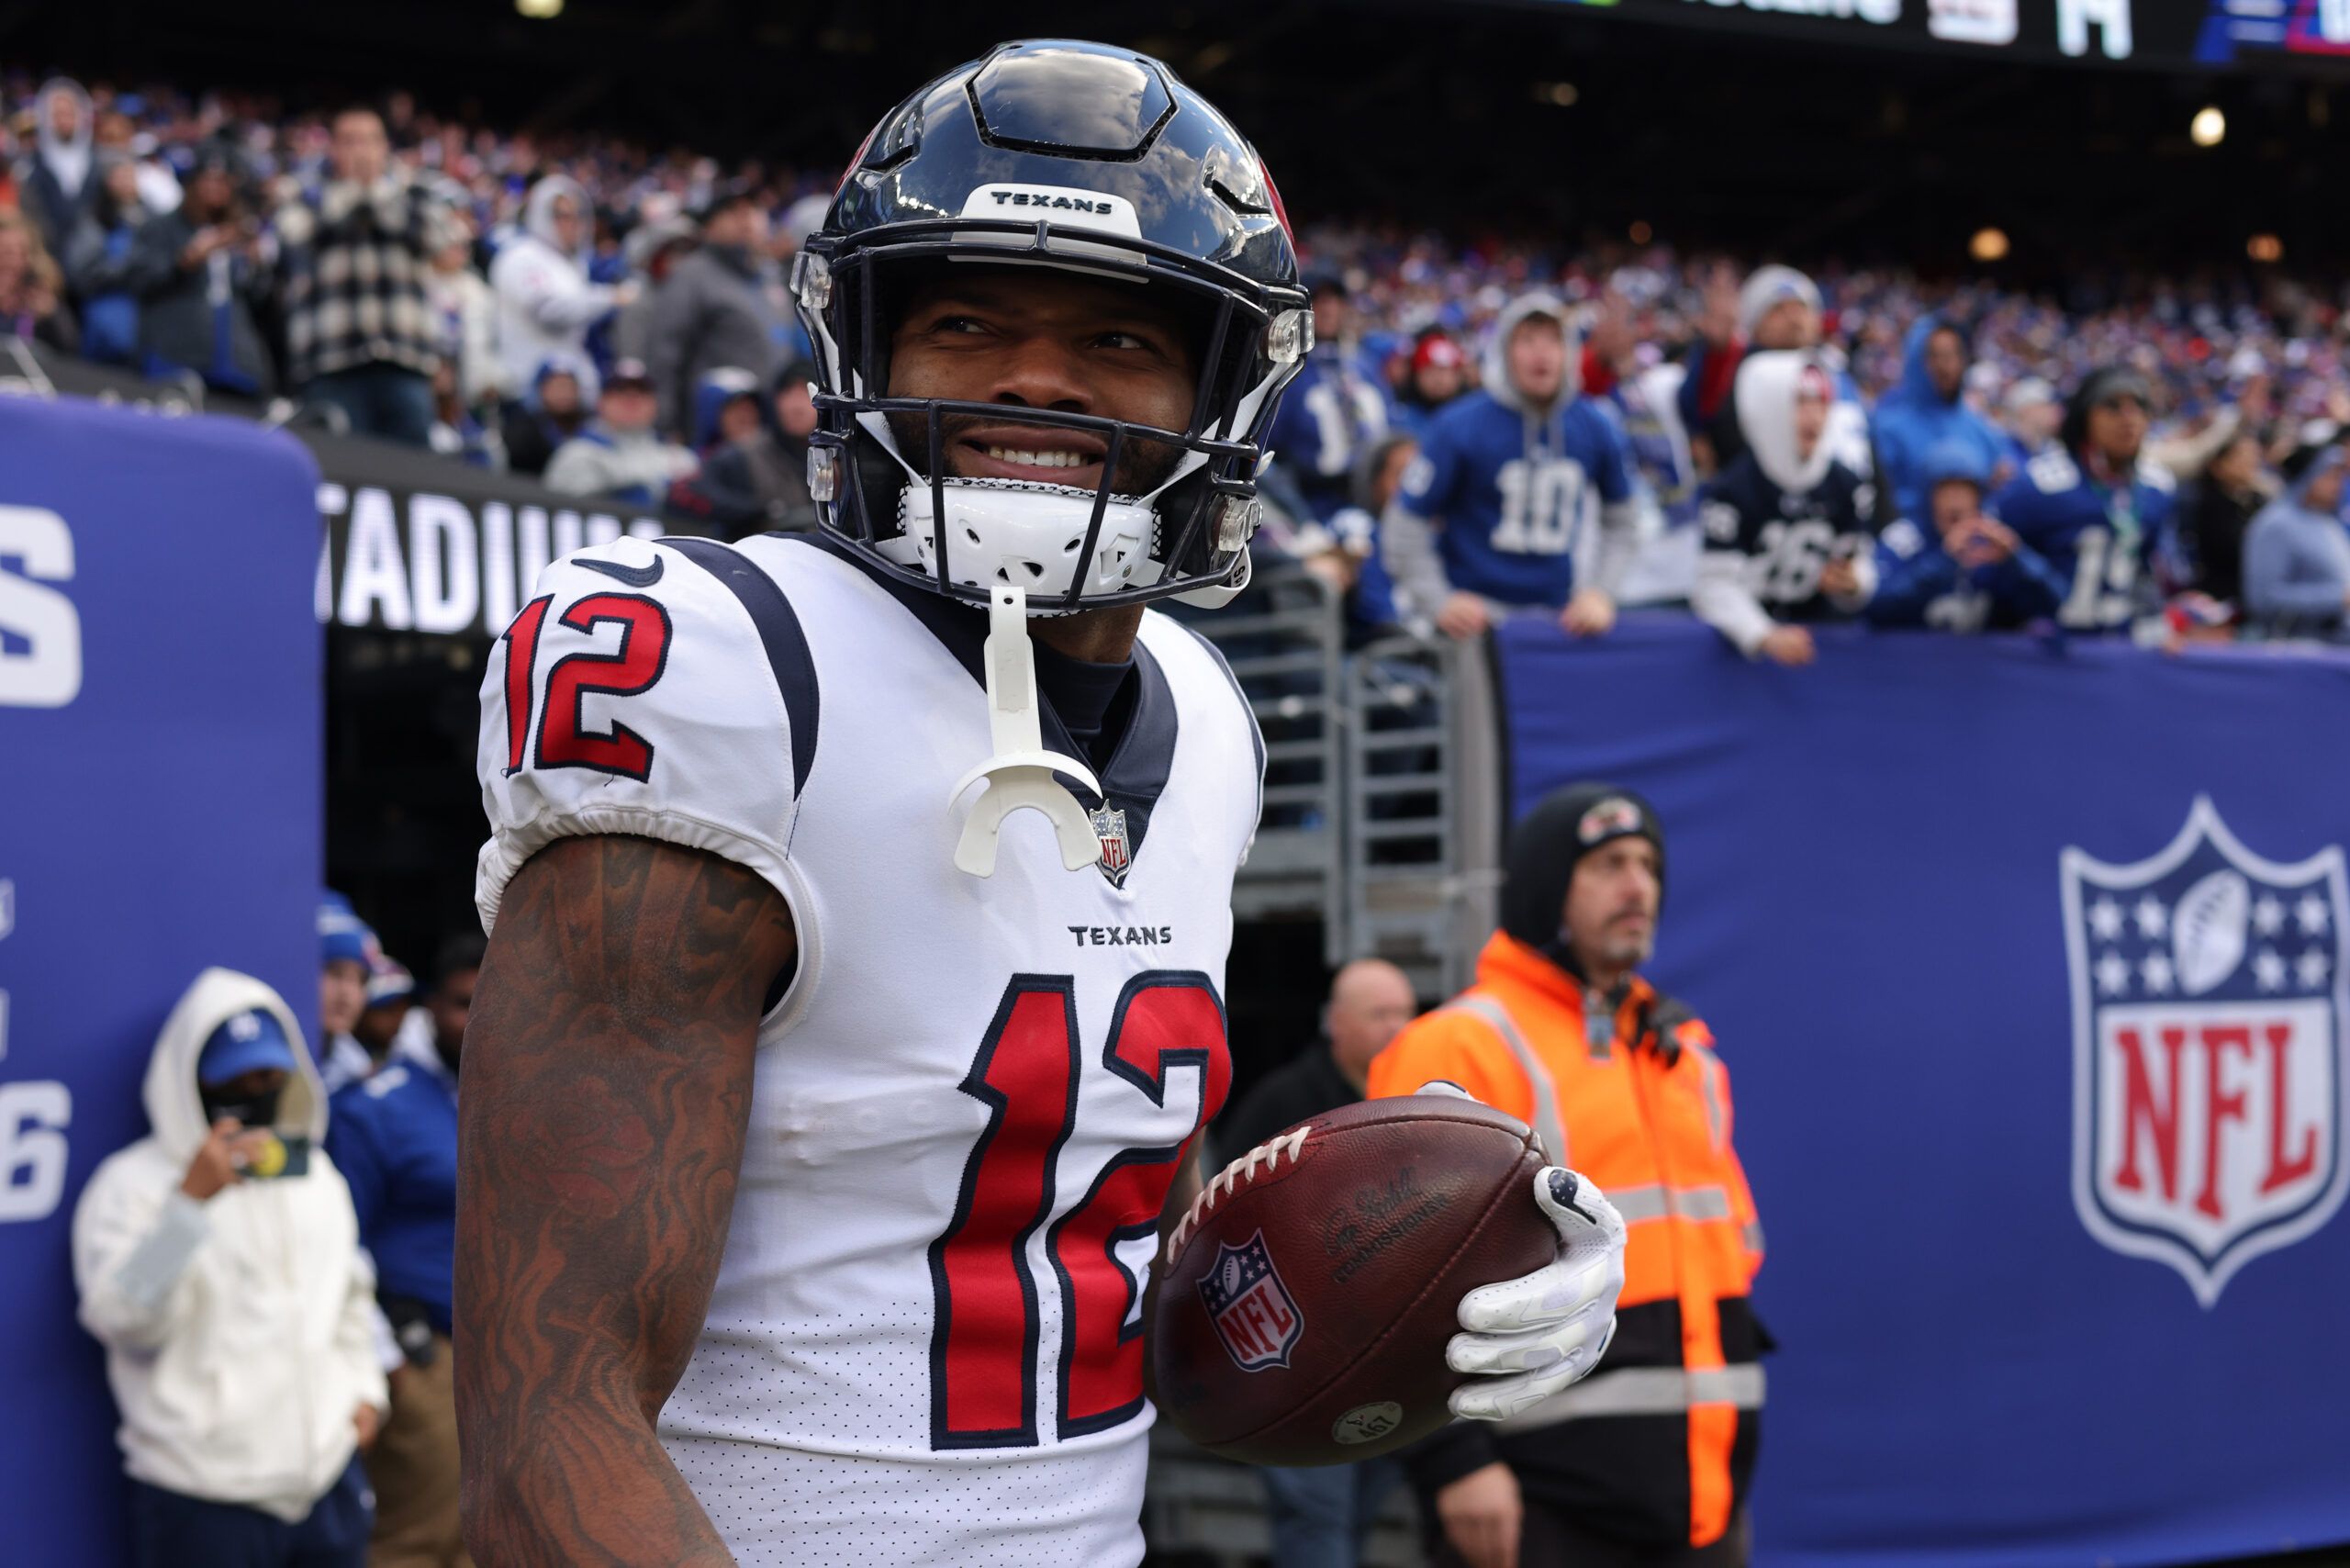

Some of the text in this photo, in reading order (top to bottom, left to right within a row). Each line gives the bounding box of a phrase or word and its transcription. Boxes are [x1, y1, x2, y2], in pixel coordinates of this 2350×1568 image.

[990, 191, 1113, 215] TEXANS
[1491, 459, 1588, 554] 10
[501, 592, 673, 785] 12
[1101, 839, 1127, 869] NFL
[1068, 926, 1172, 946] TEXANS
[2114, 1021, 2320, 1223] NFL
[928, 969, 1232, 1450] 12
[1218, 1284, 1294, 1361] NFL
[1358, 1415, 1394, 1439] 467
